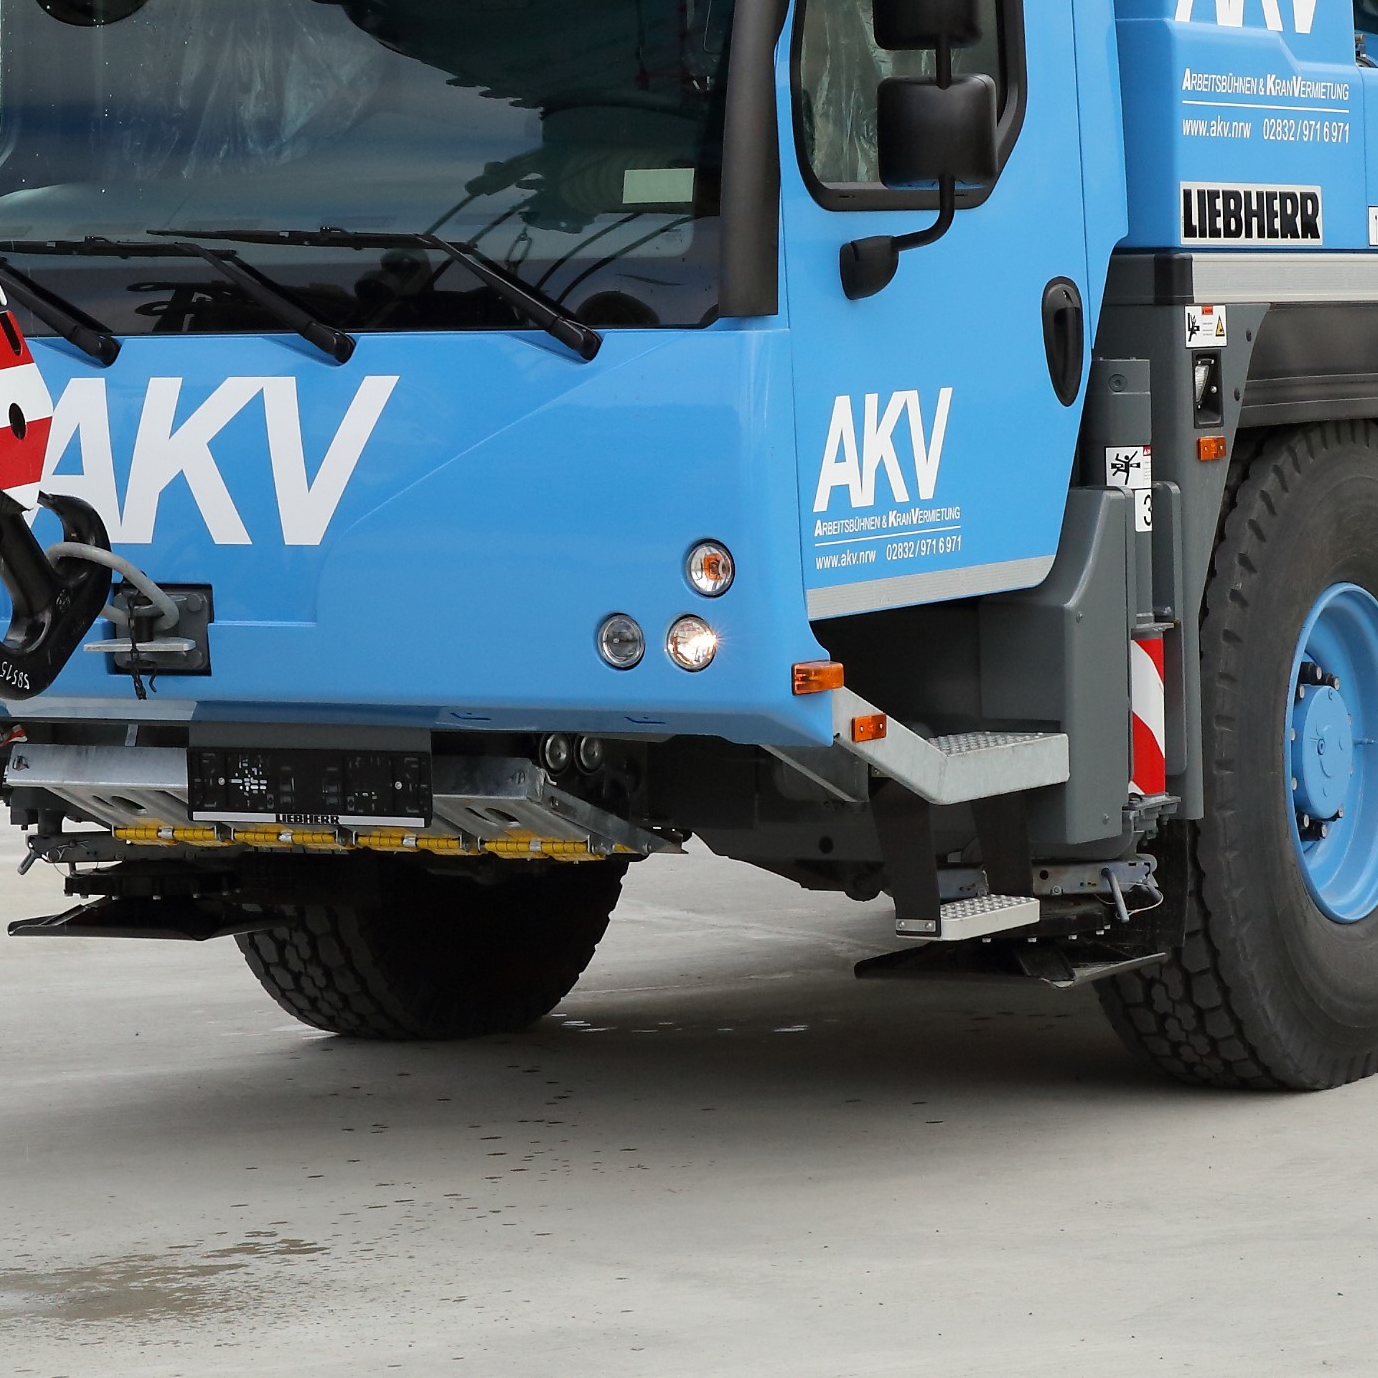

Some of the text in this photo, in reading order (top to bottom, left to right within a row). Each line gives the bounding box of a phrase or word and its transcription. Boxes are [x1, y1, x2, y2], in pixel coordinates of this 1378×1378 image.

[1258, 80, 1265, 96] &
[1182, 115, 1252, 138] www.akv.nrw
[1183, 188, 1321, 239] LIEBHERR
[23, 375, 400, 546] AKV
[813, 387, 953, 512] AKV
[882, 515, 888, 529] &
[815, 549, 877, 570] www.akv.nrw
[276, 813, 340, 825] LIEBHERR
